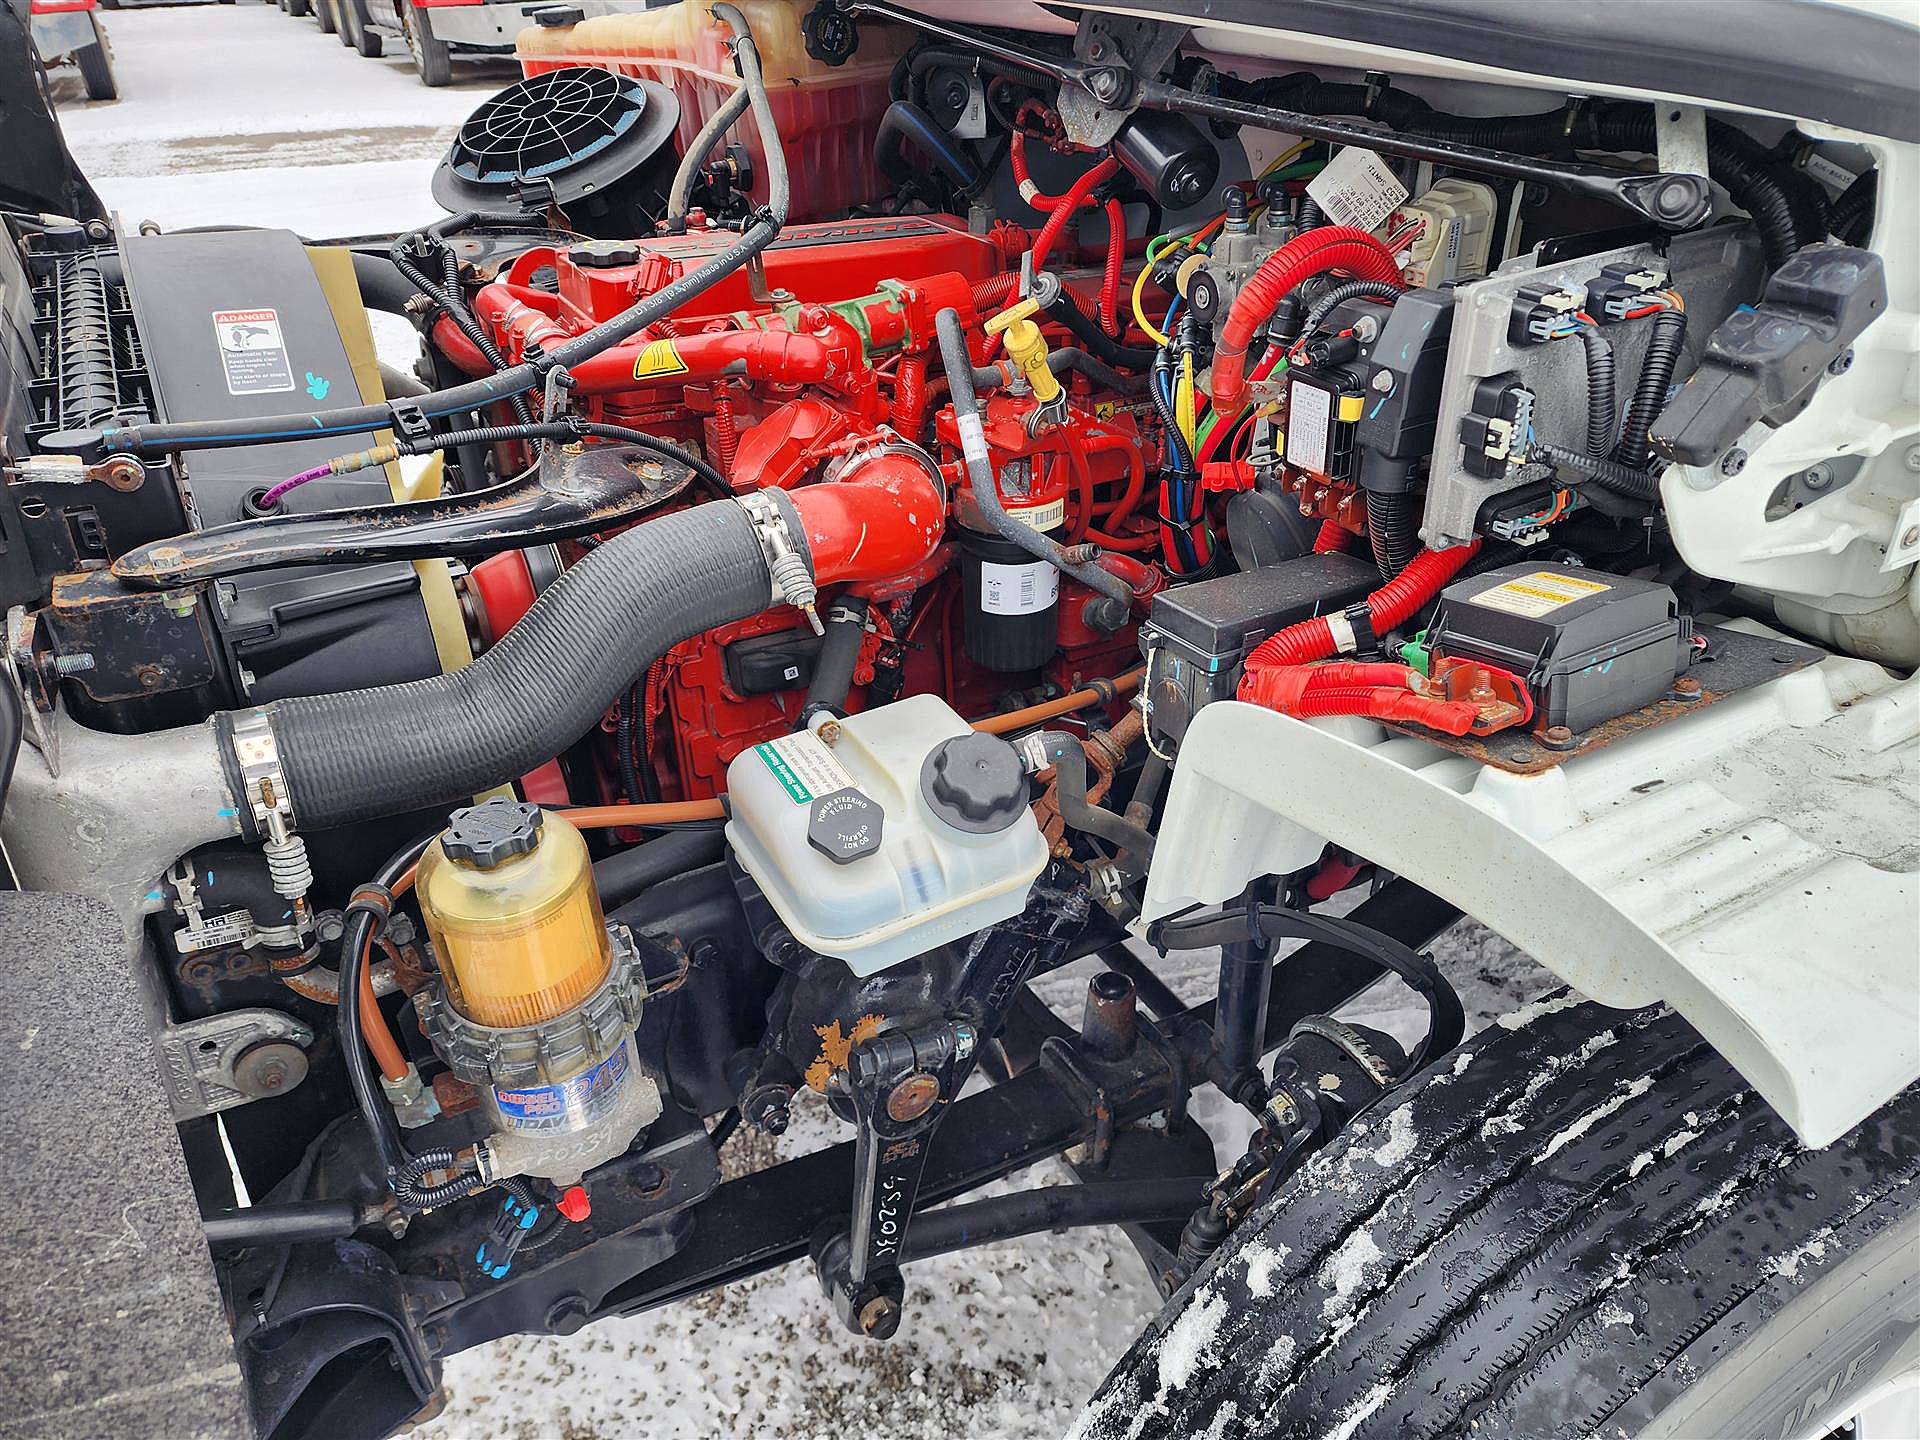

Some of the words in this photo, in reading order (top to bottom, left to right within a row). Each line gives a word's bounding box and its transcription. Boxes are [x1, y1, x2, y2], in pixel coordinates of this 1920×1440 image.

[611, 314, 635, 330] Class
[699, 263, 720, 280] Made
[229, 313, 274, 322] DANGER
[760, 744, 781, 767] Reservoir
[777, 763, 796, 786] Steering
[791, 782, 808, 800] Power
[817, 800, 834, 823] POWER
[834, 796, 868, 809] STEERING
[830, 803, 853, 816] FLUID
[837, 825, 868, 842] OVERFILL
[860, 836, 870, 846] DO
[843, 841, 859, 849] NOT
[497, 1091, 560, 1105] DIESEL
[524, 1101, 561, 1116] PRO
